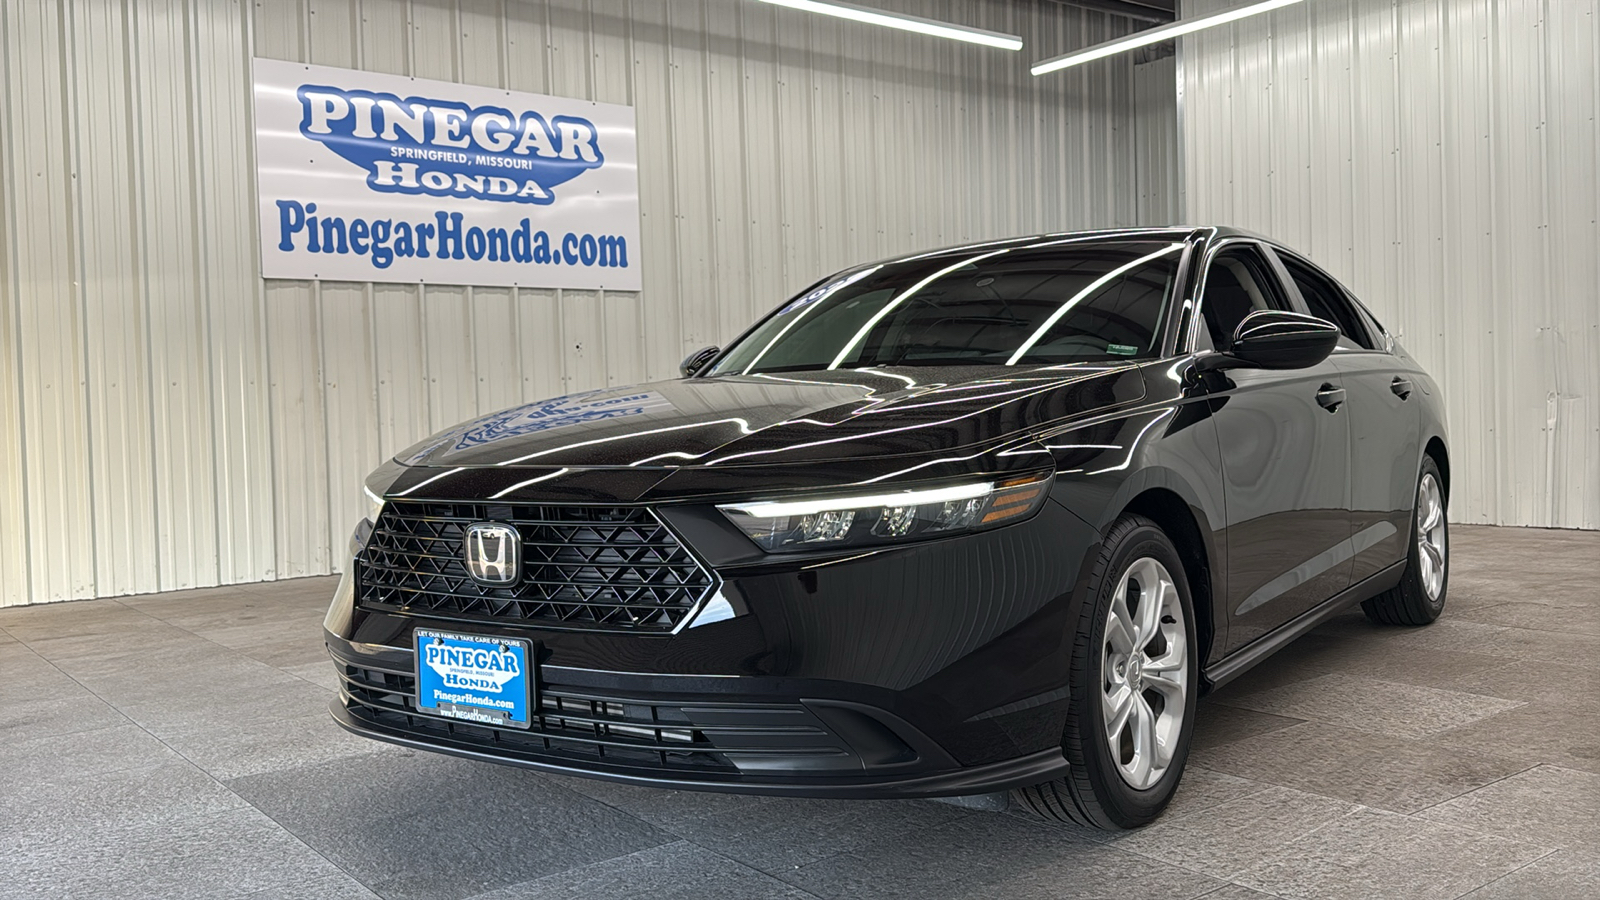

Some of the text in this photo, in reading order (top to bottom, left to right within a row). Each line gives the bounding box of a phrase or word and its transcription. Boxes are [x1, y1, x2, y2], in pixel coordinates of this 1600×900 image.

[303, 91, 599, 163] PINEGAR
[390, 146, 532, 171] SPRINGFIELD, MISSOURI
[372, 160, 550, 199] HONDA
[276, 199, 628, 269] PinegarHonda.com
[441, 633, 459, 641] FAMILY
[500, 640, 521, 648] YOURS
[427, 646, 518, 673] PINEGAR
[445, 673, 500, 690] HONDA
[433, 689, 515, 709] PinegarHonda.com
